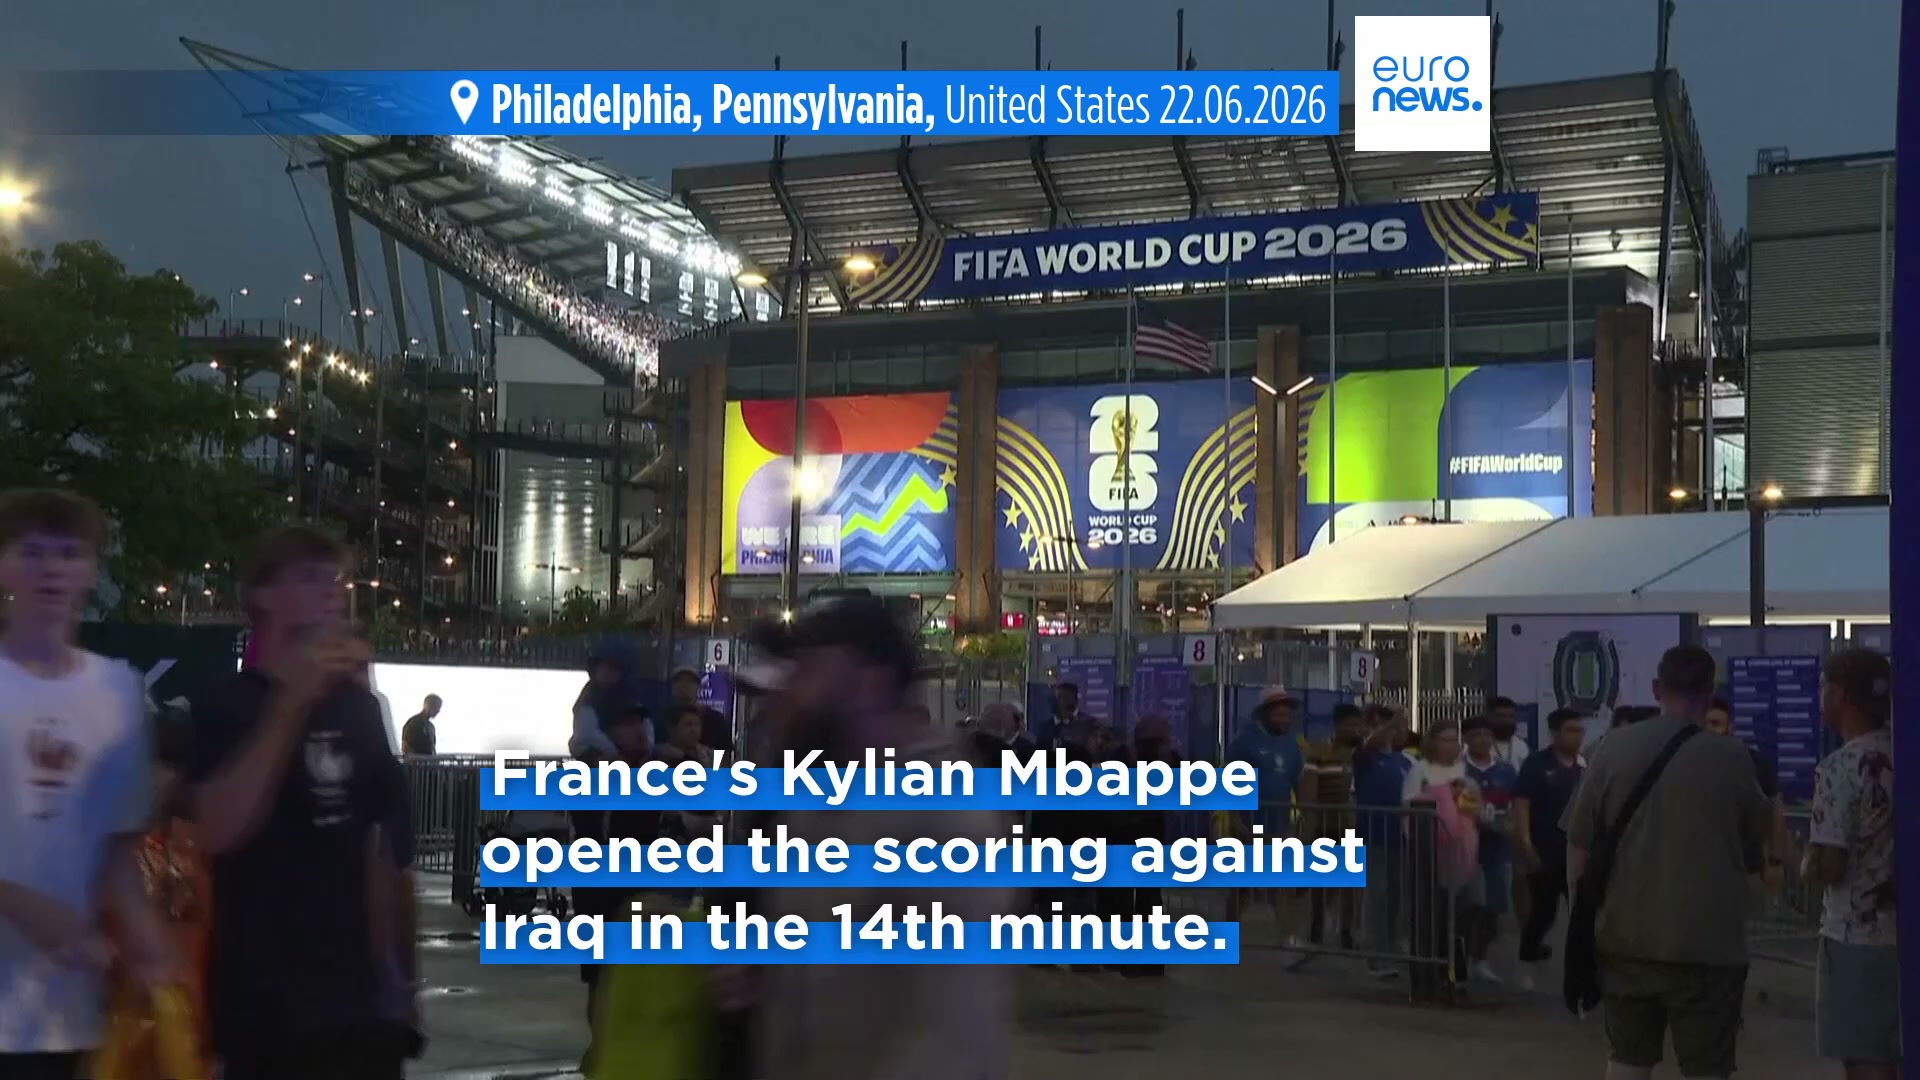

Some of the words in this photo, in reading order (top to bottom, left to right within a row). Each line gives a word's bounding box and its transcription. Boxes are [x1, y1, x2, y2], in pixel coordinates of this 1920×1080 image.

[954, 247, 1030, 282] FIFA
[1035, 237, 1172, 276] WORLD
[1178, 230, 1257, 266] CUP
[1264, 218, 1408, 260] 2026
[1449, 453, 1563, 475] #FIFAWorldCup
[1133, 514, 1158, 526] CUP
[741, 526, 780, 546] WE
[785, 524, 834, 546] RE
[714, 642, 723, 661] 6
[1193, 639, 1206, 662] 8
[1358, 656, 1368, 679] 8
